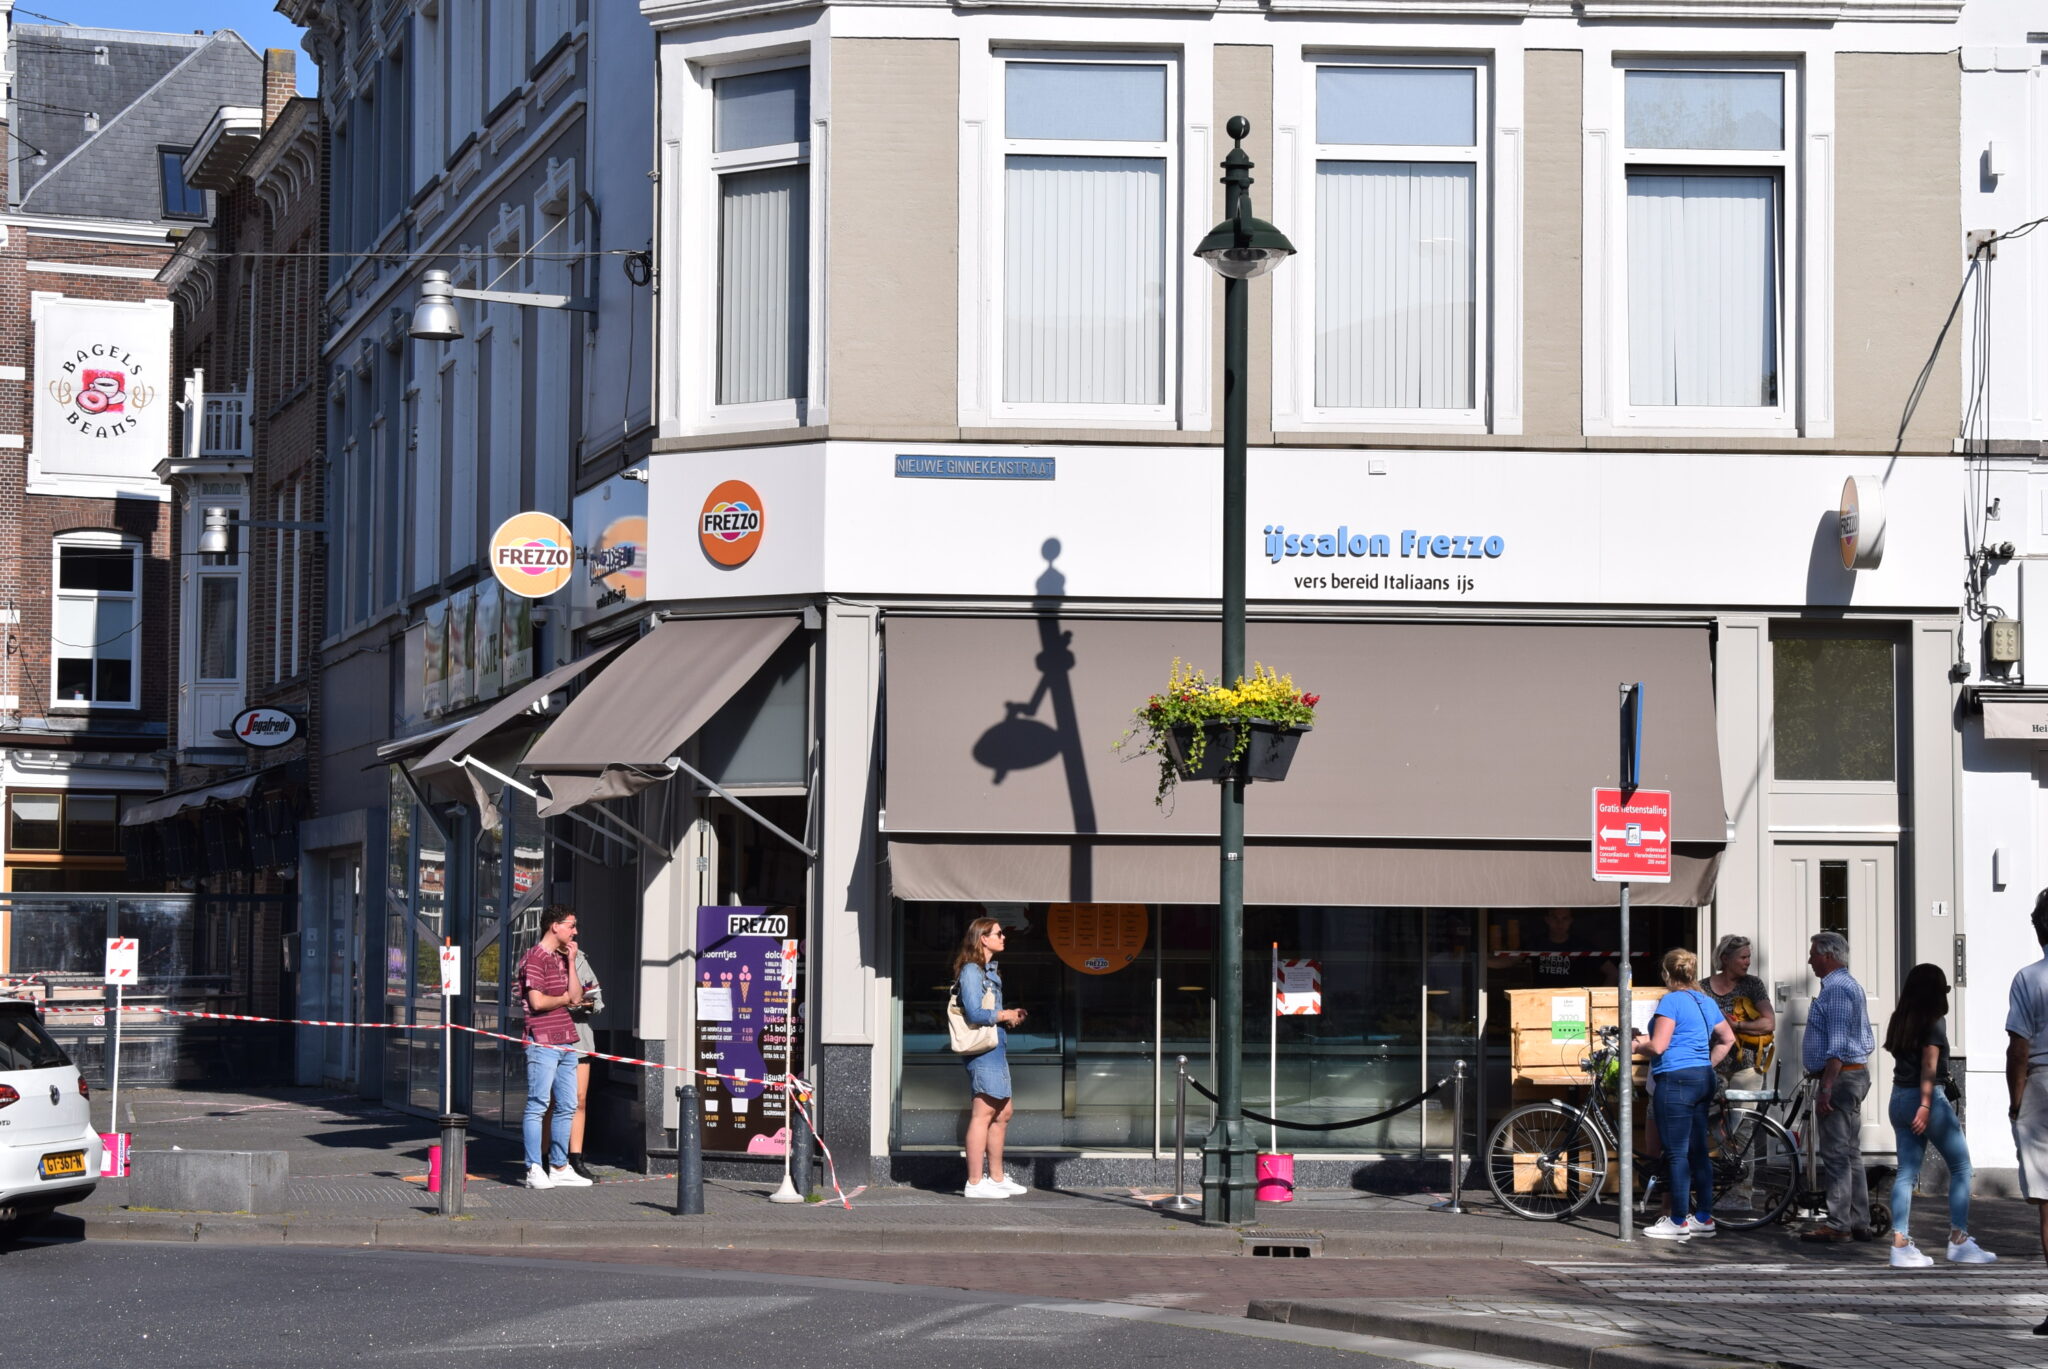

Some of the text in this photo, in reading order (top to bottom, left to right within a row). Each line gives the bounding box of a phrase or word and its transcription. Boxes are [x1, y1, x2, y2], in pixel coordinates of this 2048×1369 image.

[62, 344, 143, 375] BAGELS
[66, 412, 137, 438] BEANS
[897, 459, 1054, 475] NIEUWE GINNEKENSTRAAT
[704, 513, 759, 531] FREZZO
[1841, 515, 1857, 535] FREZZO
[1264, 525, 1505, 564] ijssalon Frezzo
[499, 548, 569, 566] FREZZO
[1294, 573, 1475, 594] vers bereid Italiaans ijs
[240, 713, 290, 736] Segafredo
[1600, 803, 1619, 813] Gratis
[730, 917, 786, 934] FREZZO
[702, 949, 737, 961] hoorntjes
[1539, 965, 1570, 975] STERK
